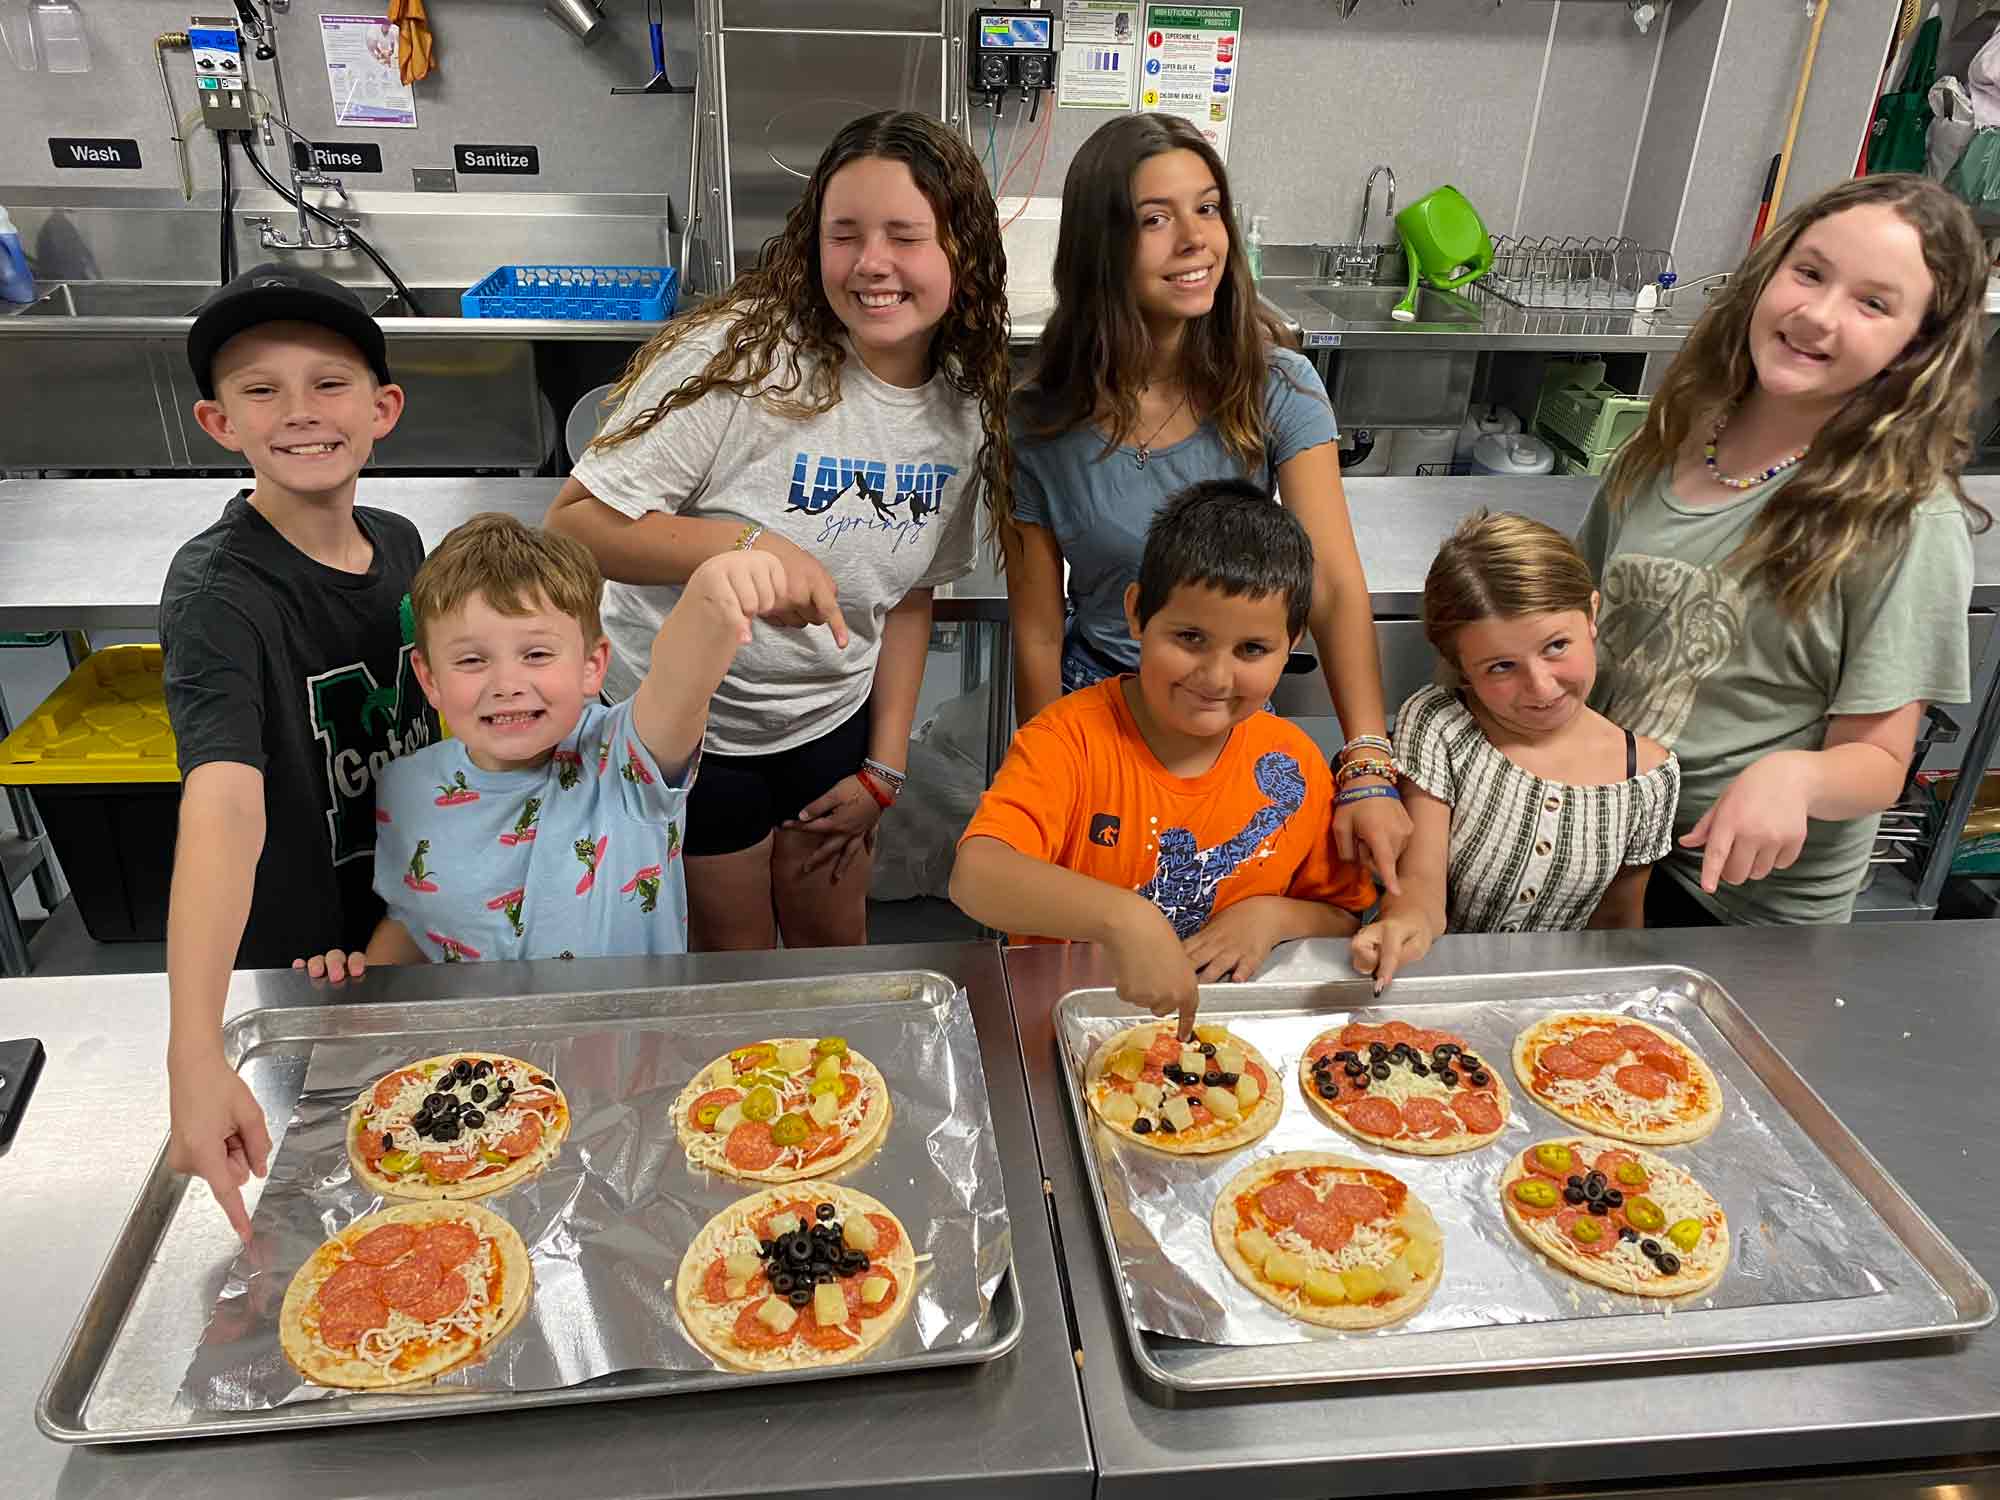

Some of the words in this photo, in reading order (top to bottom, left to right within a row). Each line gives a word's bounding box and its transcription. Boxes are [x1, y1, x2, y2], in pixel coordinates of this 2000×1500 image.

[70, 145, 121, 161] Wash
[314, 149, 362, 165] Rinse
[464, 151, 529, 167] Sanitize
